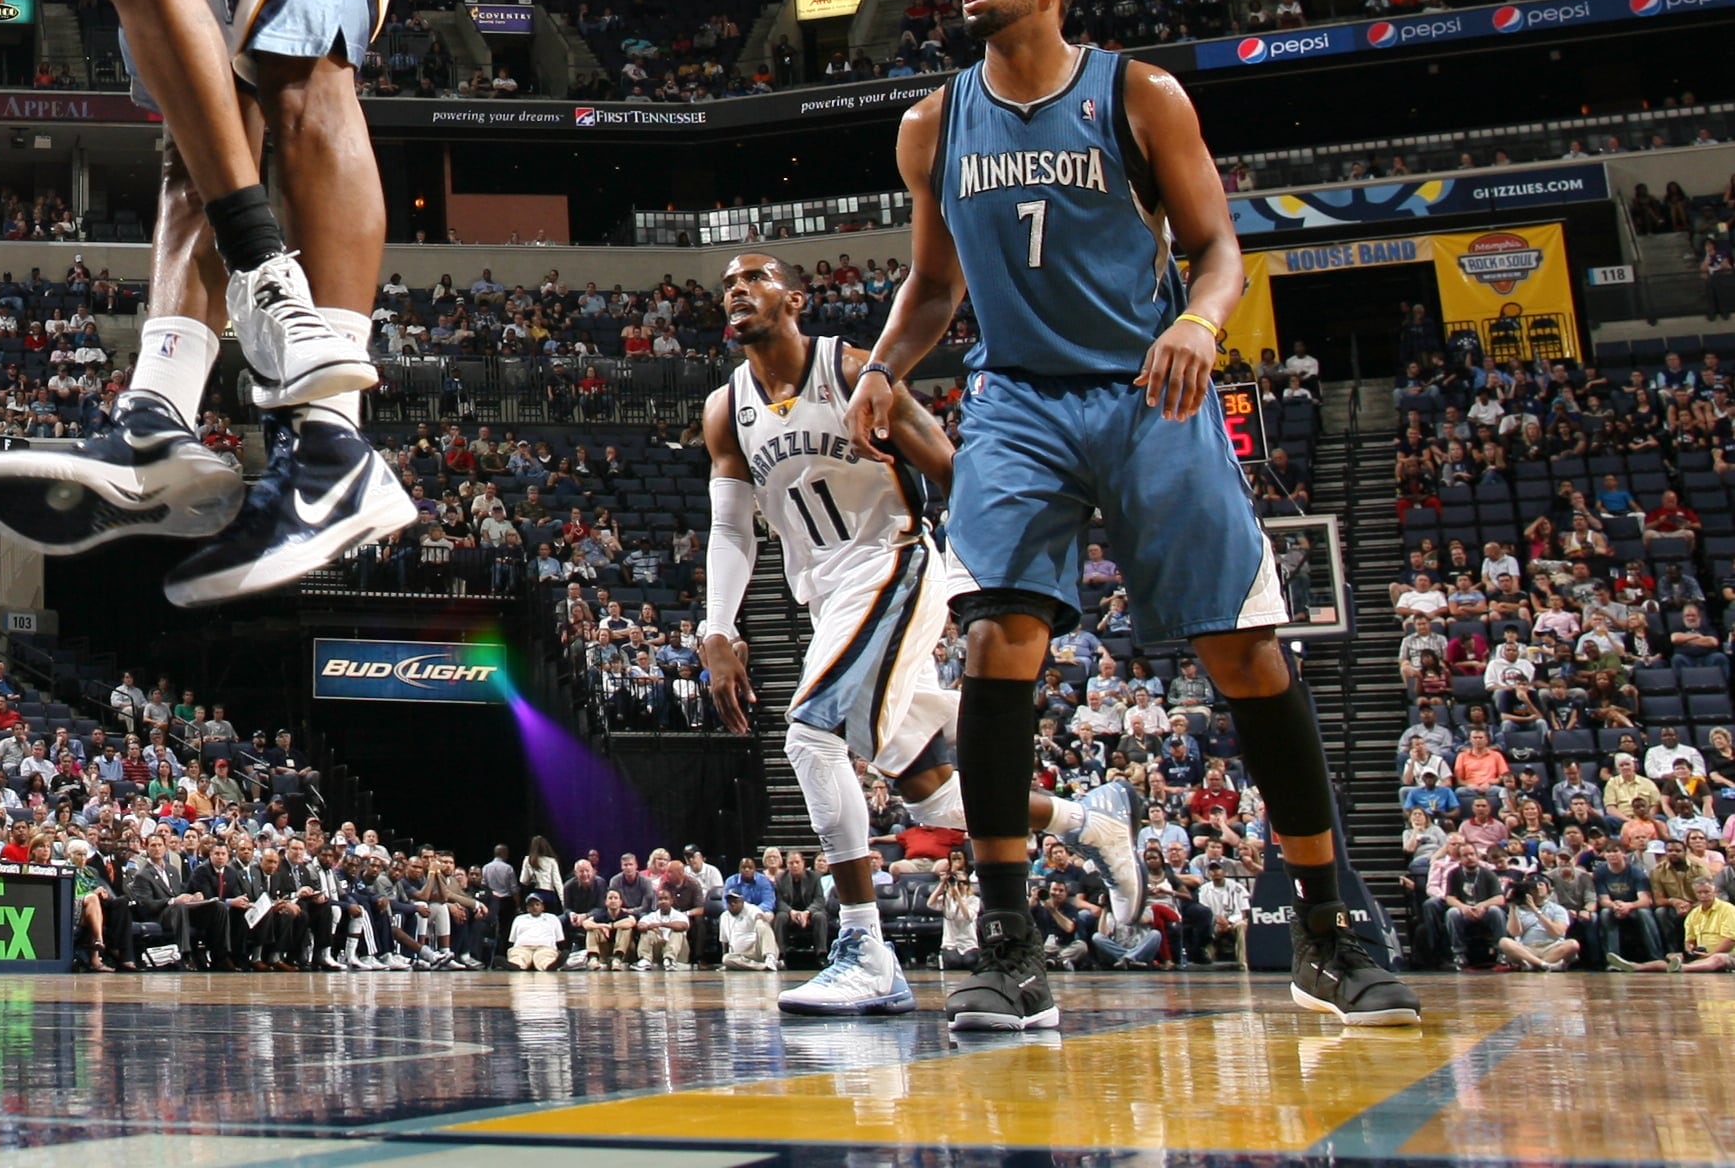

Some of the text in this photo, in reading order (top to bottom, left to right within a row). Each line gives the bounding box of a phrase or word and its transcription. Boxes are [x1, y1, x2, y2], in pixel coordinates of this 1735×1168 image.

[479, 12, 531, 20] COVENTRY
[1527, 2, 1590, 27] pepsi
[1400, 18, 1462, 41] pepsi
[1270, 33, 1330, 59] pepsi
[4, 96, 94, 119] APPEAL
[801, 86, 933, 114] powering your dreams
[432, 108, 706, 125] powering your dreams FIRST TENNESSEE
[958, 147, 1108, 199] MINNESOTA
[1017, 200, 1046, 268] 7
[1286, 240, 1417, 272] HOUSE BAND
[1468, 258, 1497, 270] ROCK
[1506, 254, 1534, 267] SOUL
[1601, 267, 1626, 282] 118
[750, 431, 860, 487] GRIZZLIES
[788, 479, 850, 546] 11
[13, 616, 32, 629] 103
[321, 659, 497, 682] BUD LIGHT
